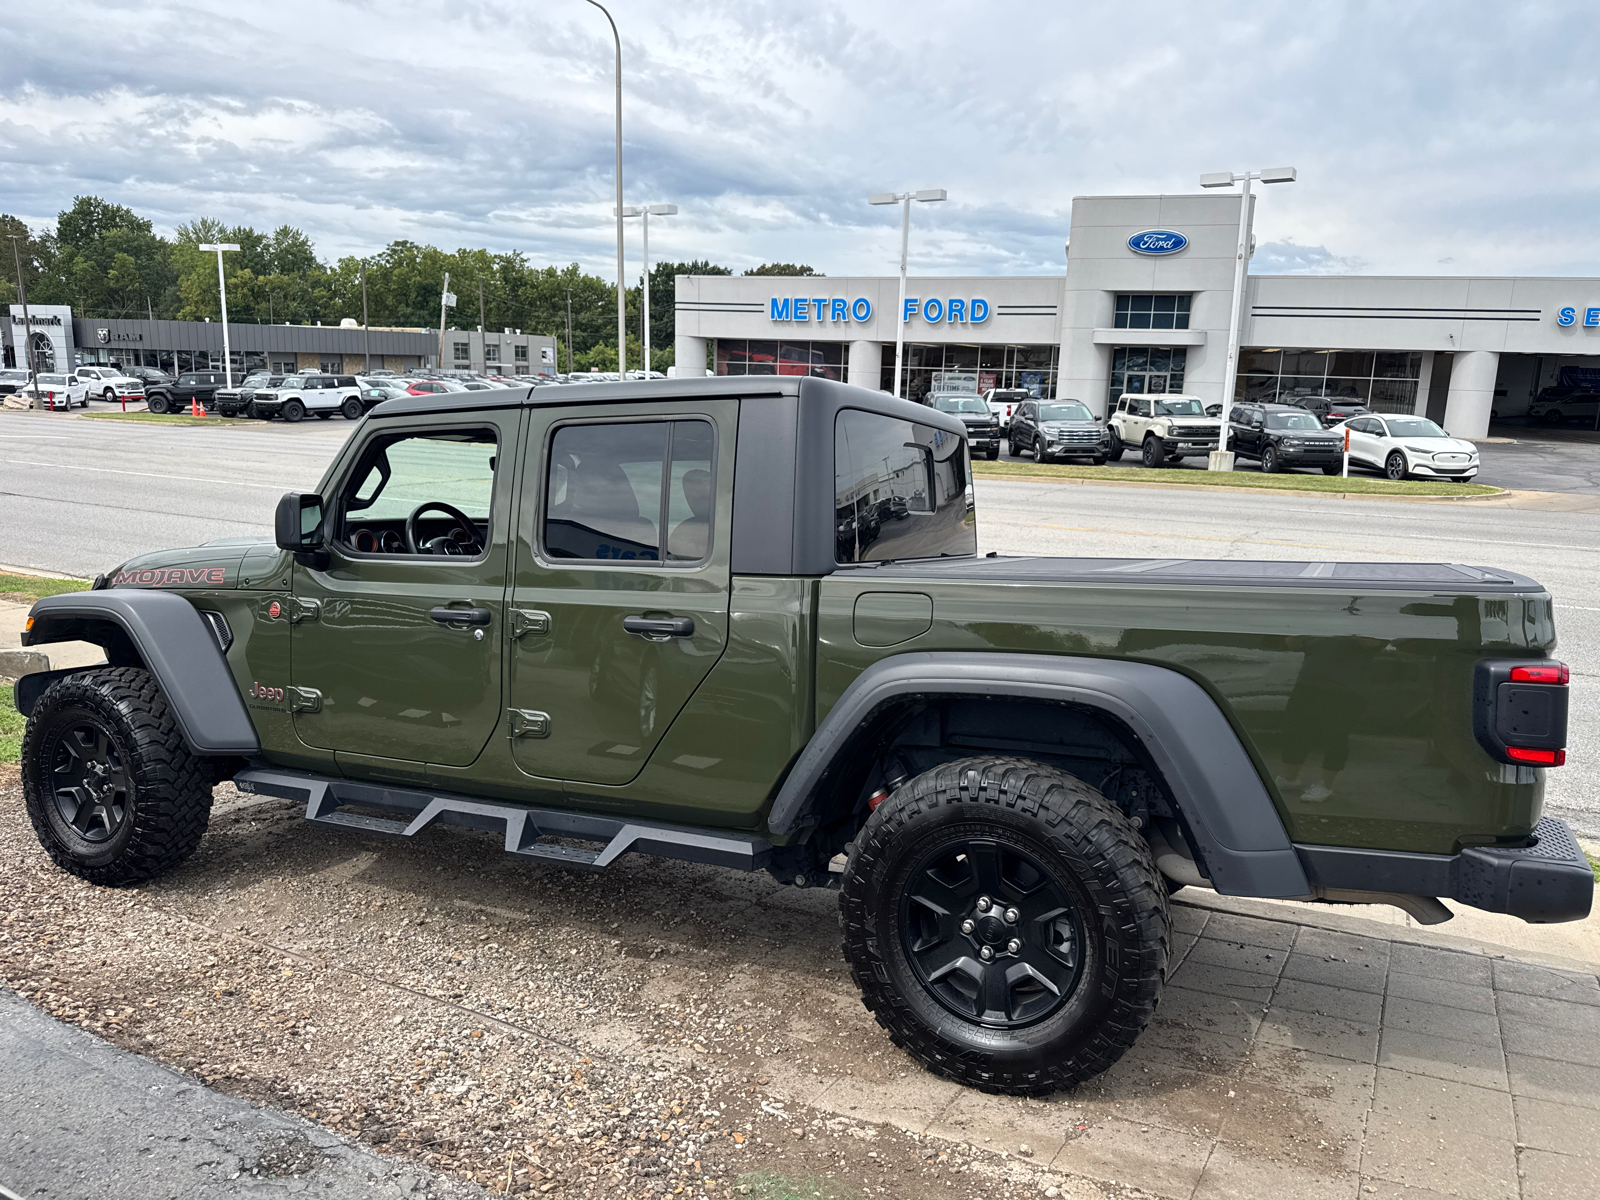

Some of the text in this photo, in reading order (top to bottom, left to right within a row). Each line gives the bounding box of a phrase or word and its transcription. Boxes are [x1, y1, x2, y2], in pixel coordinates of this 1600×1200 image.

[1140, 233, 1176, 249] Ford
[769, 297, 990, 324] METRO FORD
[1557, 306, 1600, 327] SE
[111, 332, 143, 342] RAM
[113, 567, 226, 587] MOJAVE
[248, 681, 284, 705] Jeep
[249, 703, 281, 713] GLADIATOR
[1041, 831, 1120, 1000] FALKEN
[985, 920, 998, 940] Jeep
[863, 904, 994, 1068] WILDPEAK
